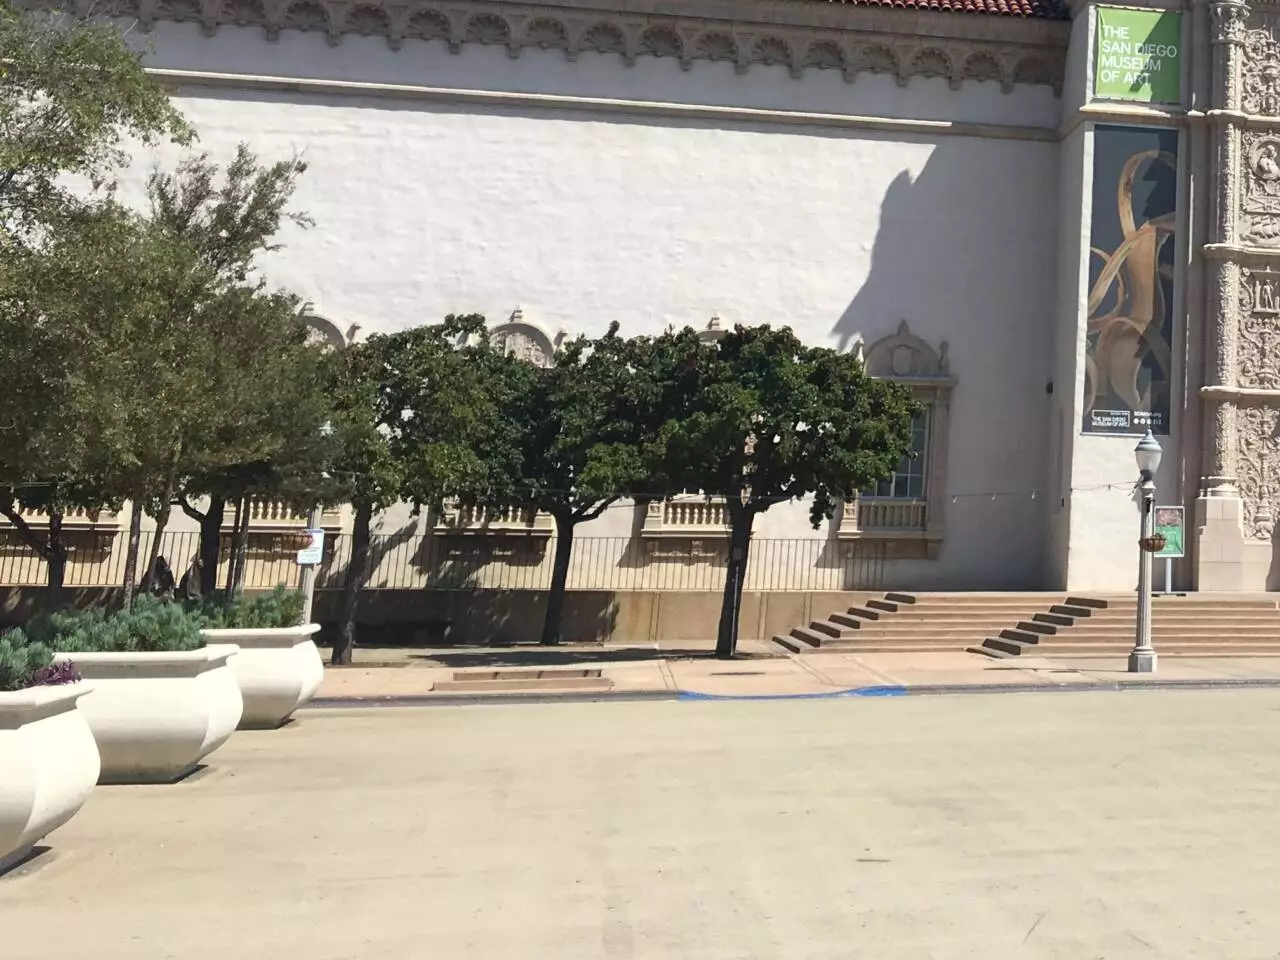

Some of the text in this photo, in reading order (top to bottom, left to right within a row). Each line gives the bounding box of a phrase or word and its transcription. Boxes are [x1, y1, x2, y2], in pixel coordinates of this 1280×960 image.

[1102, 25, 1130, 39] THE
[1102, 40, 1178, 58] SAN DIEGO
[1101, 54, 1161, 71] MUSEUM
[1101, 70, 1151, 85] OF ART
